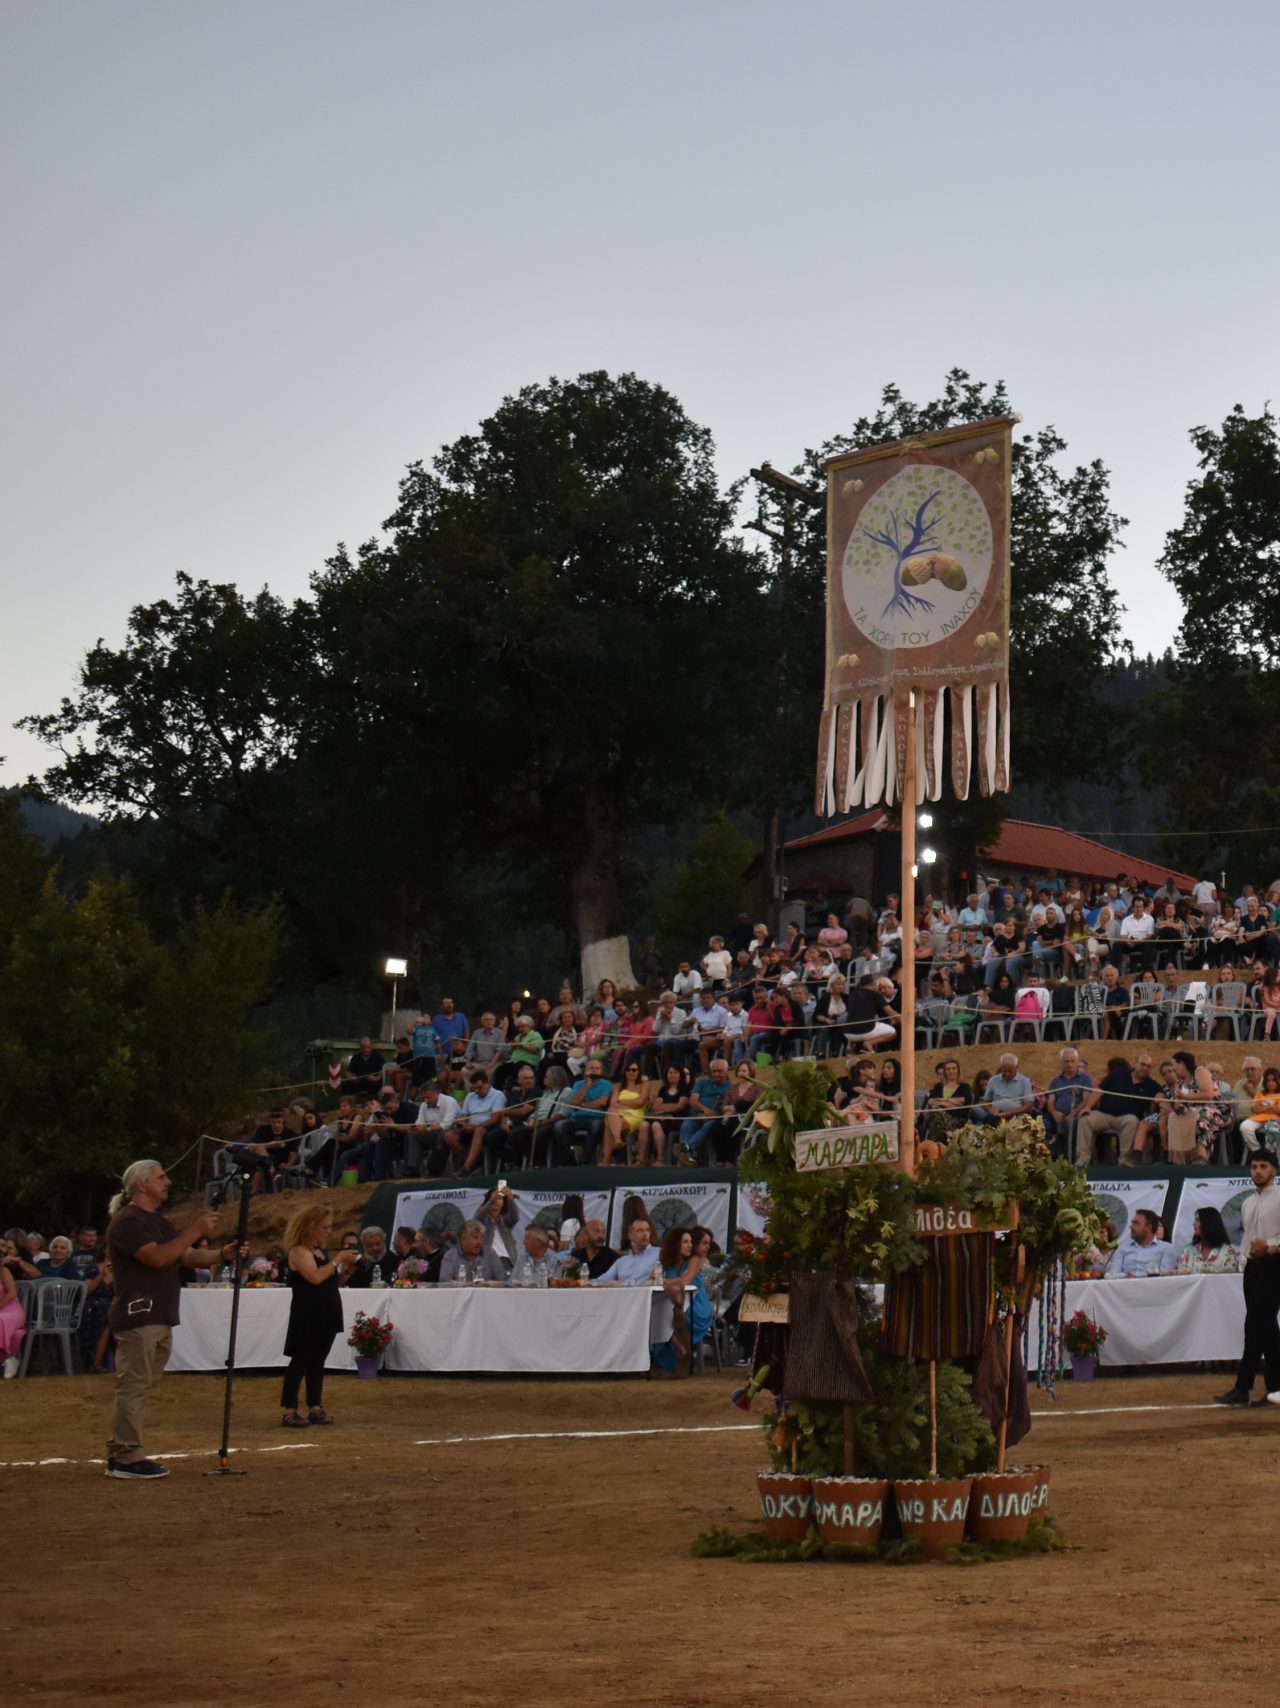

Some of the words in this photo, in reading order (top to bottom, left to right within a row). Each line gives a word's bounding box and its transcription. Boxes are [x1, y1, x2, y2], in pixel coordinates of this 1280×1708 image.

[854, 606, 868, 626] ΤΑ
[901, 630, 931, 644] ΤΟΥ
[940, 586, 981, 635] ΙΝΑΧΟΥ
[799, 1133, 891, 1169] ΜΑΡΜΑΡΑ
[425, 1190, 467, 1200] ΠΕΡΙΒΟΛΙ
[641, 1186, 707, 1197] ΚΥΡΙΑΚΟΧΩΡΙ
